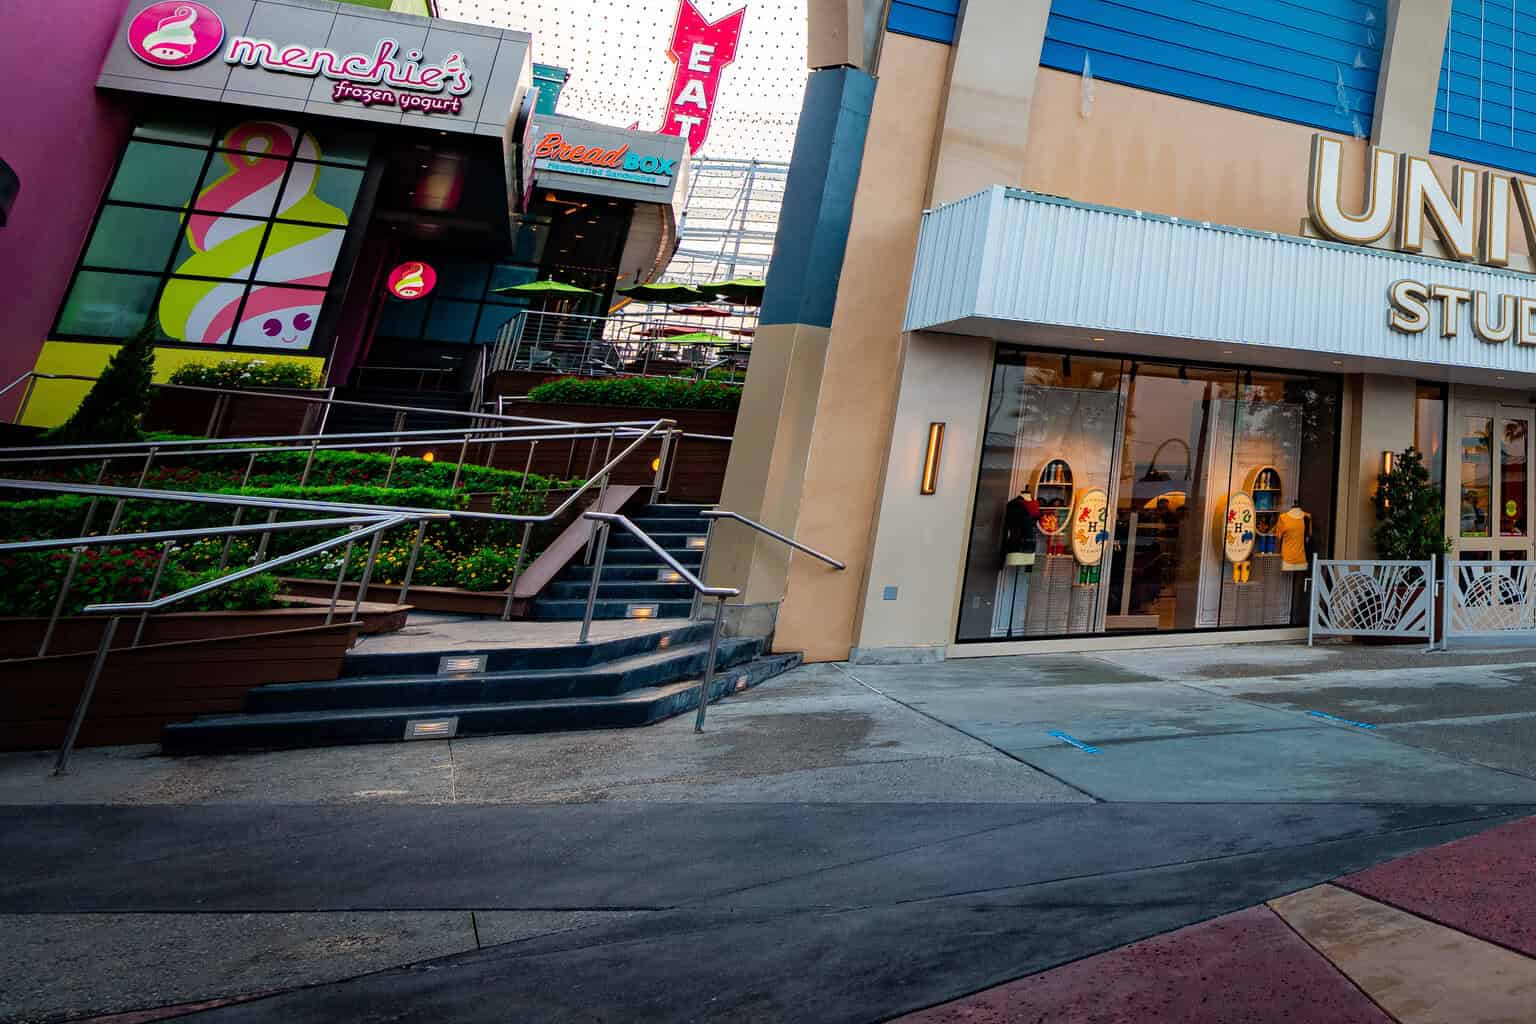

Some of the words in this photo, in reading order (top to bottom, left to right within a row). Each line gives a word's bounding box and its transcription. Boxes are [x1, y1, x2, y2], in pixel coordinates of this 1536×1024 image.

[225, 38, 471, 95] menchie's
[674, 42, 716, 137] EAT
[335, 82, 394, 103] frozen
[400, 93, 461, 111] yogurt
[535, 132, 629, 168] Bread
[623, 151, 676, 176] BOX
